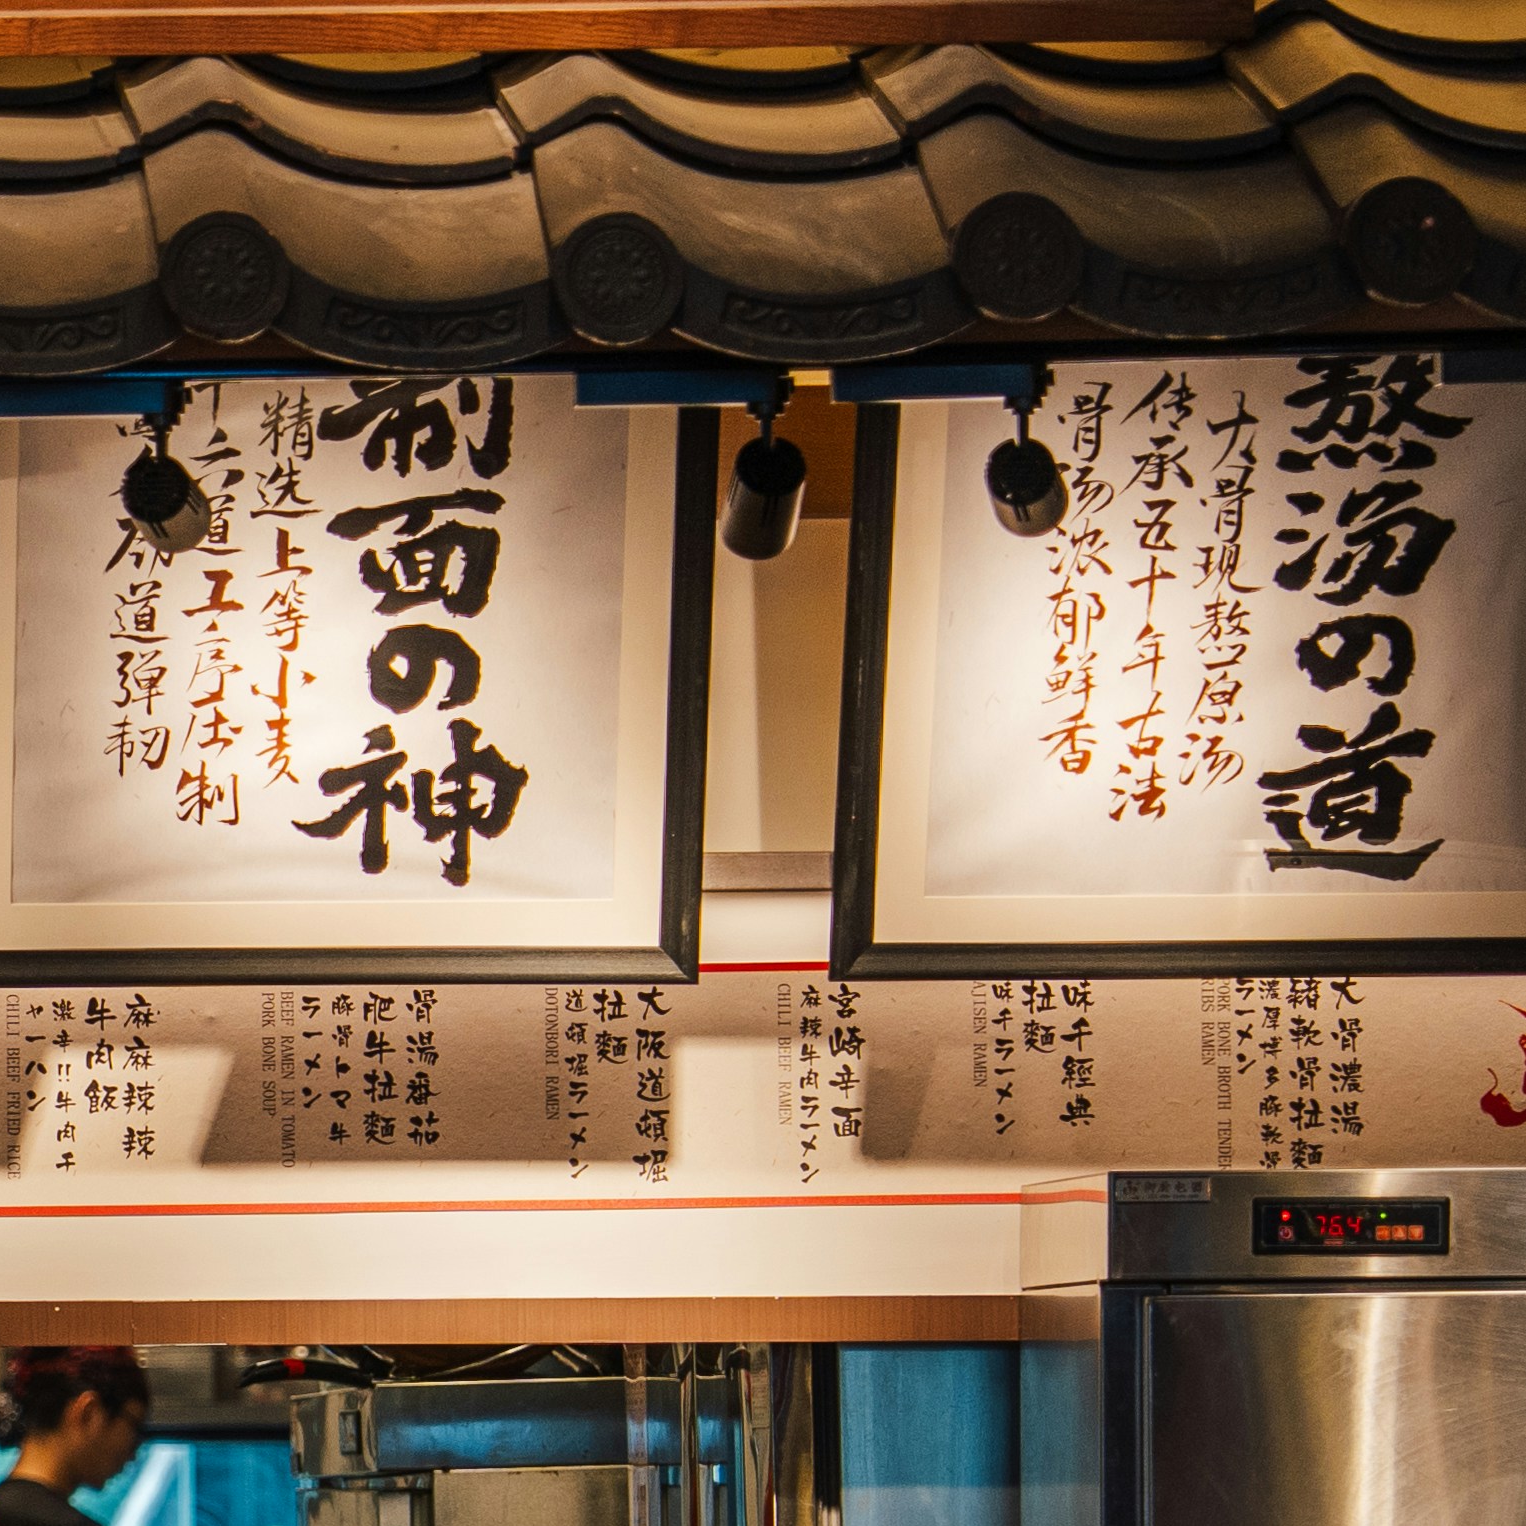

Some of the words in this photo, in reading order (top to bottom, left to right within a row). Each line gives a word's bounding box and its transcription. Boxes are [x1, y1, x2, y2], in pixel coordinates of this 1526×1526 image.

[292, 378, 529, 887] 制面の神
[5, 994, 20, 1036] CHILI
[261, 992, 276, 1028] PORK
[280, 991, 295, 1027] BEEF
[777, 984, 791, 1027] CHILI
[973, 981, 987, 1035] AJISEN
[1201, 978, 1215, 1012] RIBS
[1217, 978, 1231, 1012] PORK
[545, 987, 560, 1067] DOTONBORI
[1201, 1021, 1215, 1066] RAMEN
[1217, 1021, 1231, 1057] BONE
[1234, 979, 1256, 1075] ラーメン
[6, 1047, 21, 1083] BEEF
[84, 997, 119, 1114] 牛肉飯
[262, 1036, 276, 1071] BONE
[281, 1035, 296, 1080] RAMEN
[301, 995, 323, 1109] ラーメン
[405, 989, 440, 1147] 骨湯番茄
[778, 1036, 792, 1072] BEEF
[973, 1043, 987, 1088] RAMEN
[992, 980, 1016, 1134] 味千ラーメン
[1060, 979, 1097, 1126] 味千經典
[1329, 977, 1365, 1137] 大骨濃湯
[122, 993, 157, 1160] 麻麻辣辣
[262, 1081, 276, 1117] SOUP
[281, 1090, 295, 1106] IN
[546, 1075, 560, 1121] RAMEN
[564, 990, 590, 1179] 道頓堀ラーメン
[633, 984, 671, 1184] 大阪道頓堀
[799, 985, 822, 1183] 麻辣牛肉ラーメン
[1217, 1065, 1232, 1111] BROTH
[7, 1091, 21, 1136] FRIED
[779, 1080, 793, 1126] RAMEN
[7, 1143, 22, 1180] RICE
[281, 1114, 296, 1168] TOMATO
